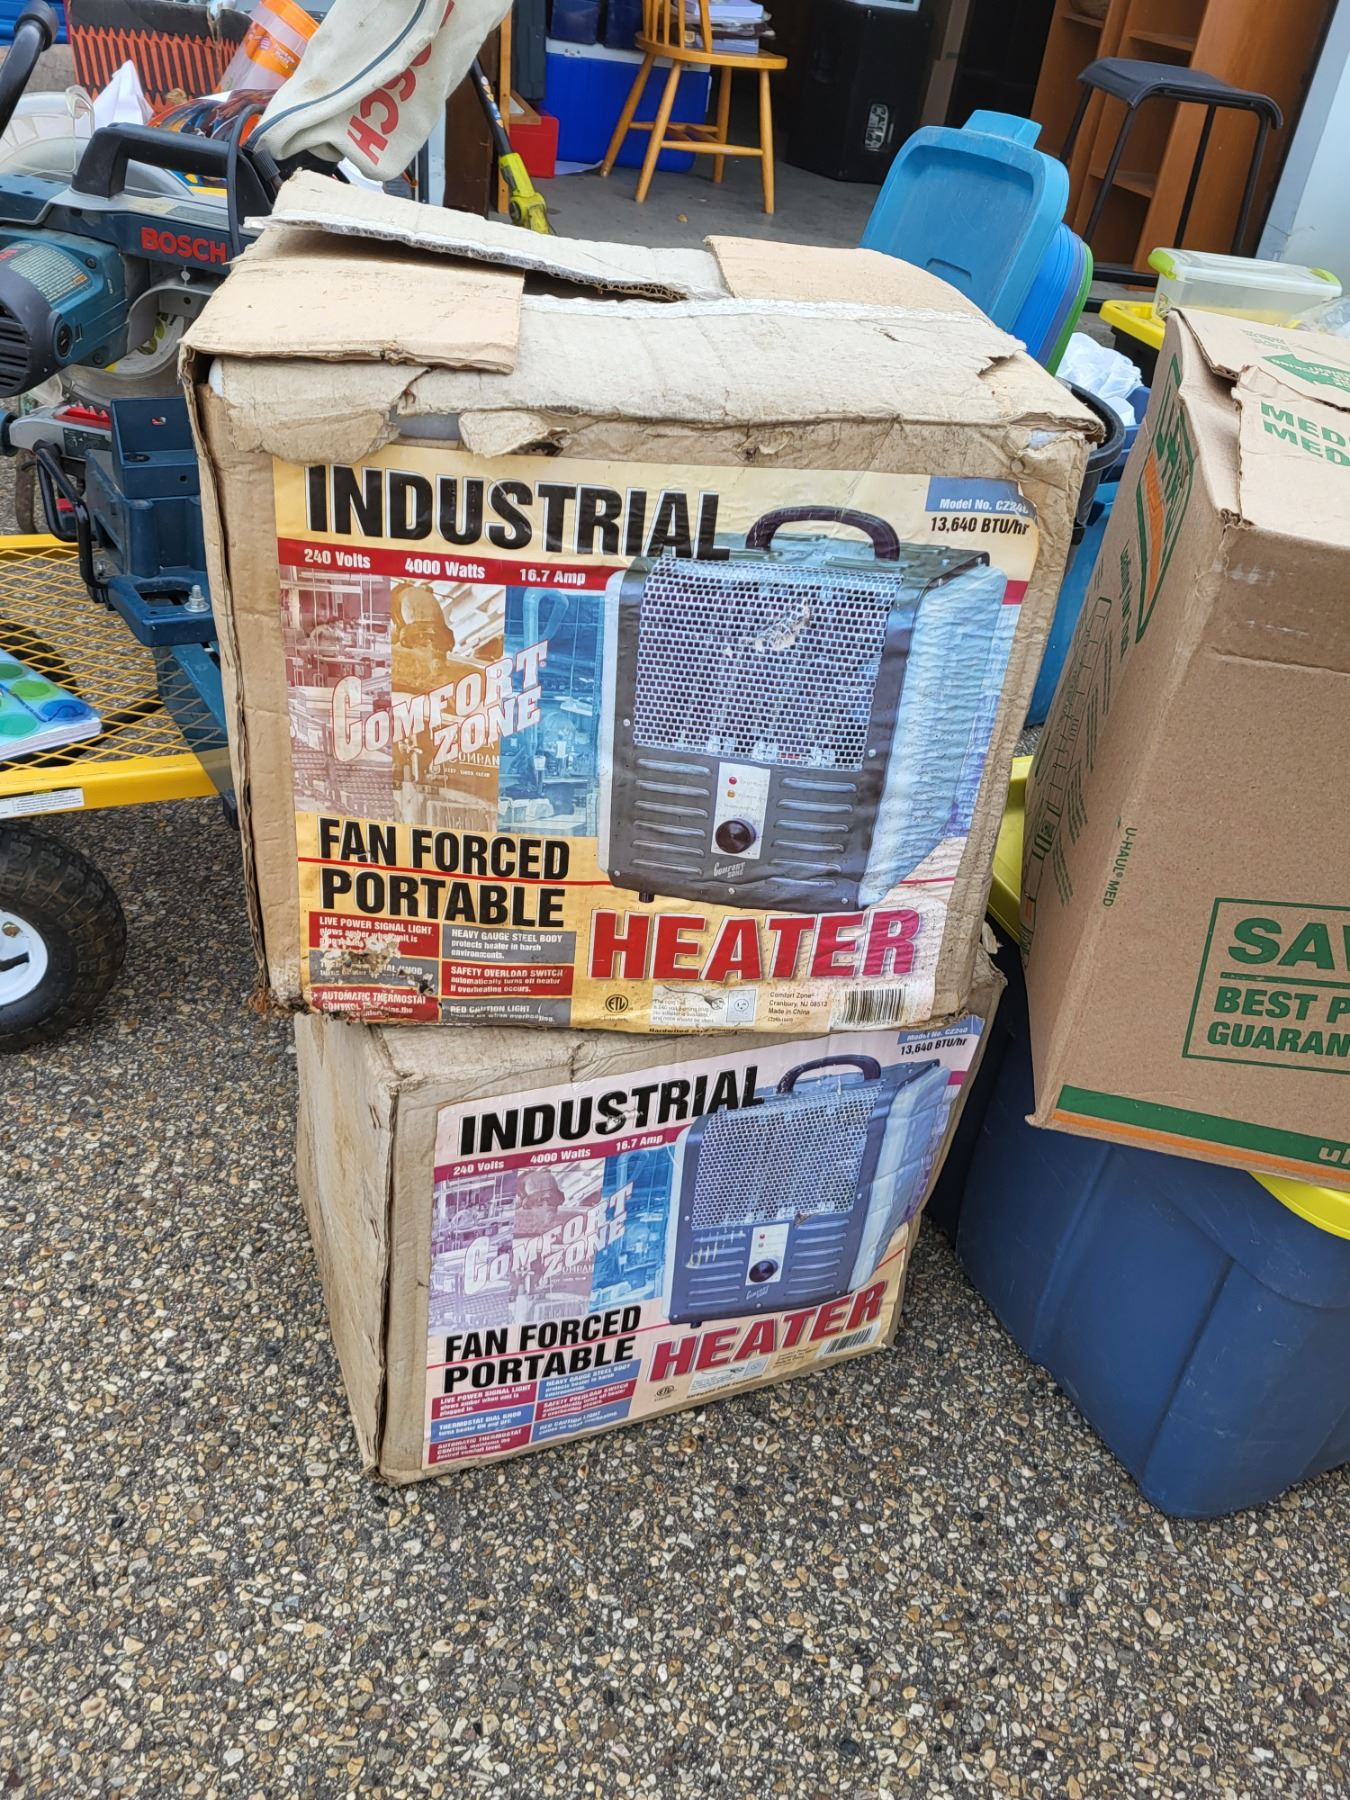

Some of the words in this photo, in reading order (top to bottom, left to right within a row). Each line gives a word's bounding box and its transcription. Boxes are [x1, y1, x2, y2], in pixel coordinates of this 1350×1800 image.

[140, 226, 228, 265] BOSCH
[304, 464, 730, 561] INDUSTRIAL
[939, 498, 972, 509] Model
[974, 499, 993, 510] No.
[931, 516, 978, 533] 13,640
[981, 517, 1030, 535] BTU/hr
[304, 548, 332, 565] 240
[335, 550, 371, 569] Volts
[404, 557, 441, 576] 4000
[445, 561, 485, 580] Watts
[519, 568, 549, 583] 16.7
[553, 569, 586, 587] Amp
[317, 816, 397, 867] FAN
[410, 827, 571, 881] FORCED
[319, 866, 567, 928] PORTABLE
[1102, 879, 1120, 908] MED
[319, 916, 338, 926] LIVE
[340, 918, 372, 930] POWER
[374, 921, 406, 933] SIGNAL
[408, 924, 433, 934] LIGHT
[451, 928, 479, 940] HEAVY
[481, 931, 510, 941] GAUGE
[512, 932, 538, 943] STEEL
[539, 933, 563, 944] BODY
[451, 939, 482, 950] protects
[510, 942, 518, 951] in
[520, 942, 541, 952] harsh
[588, 906, 921, 984] HEATER
[450, 966, 482, 977] SAFETY
[484, 967, 528, 978] OVERLOAD
[530, 968, 564, 978] SWITCH
[321, 991, 371, 1001] AUTOMATIC
[507, 1004, 531, 1013] LIGHT
[769, 991, 795, 999] Comfort
[1213, 985, 1318, 1021] BEST
[900, 1041, 933, 1055] 13,640
[935, 1037, 968, 1049] BTU/hr
[458, 1065, 766, 1157] INDUSTRIAL
[453, 1163, 475, 1176] 240
[477, 1159, 504, 1174] Volts
[529, 1151, 557, 1165] 4000
[561, 1147, 591, 1162] Watts
[616, 1139, 637, 1152] 16.7
[639, 1133, 663, 1148] Amp
[444, 1327, 508, 1362] FAN
[519, 1305, 642, 1352] FORCED
[647, 1280, 888, 1383] HEATER
[443, 1335, 636, 1394] PORTABLE
